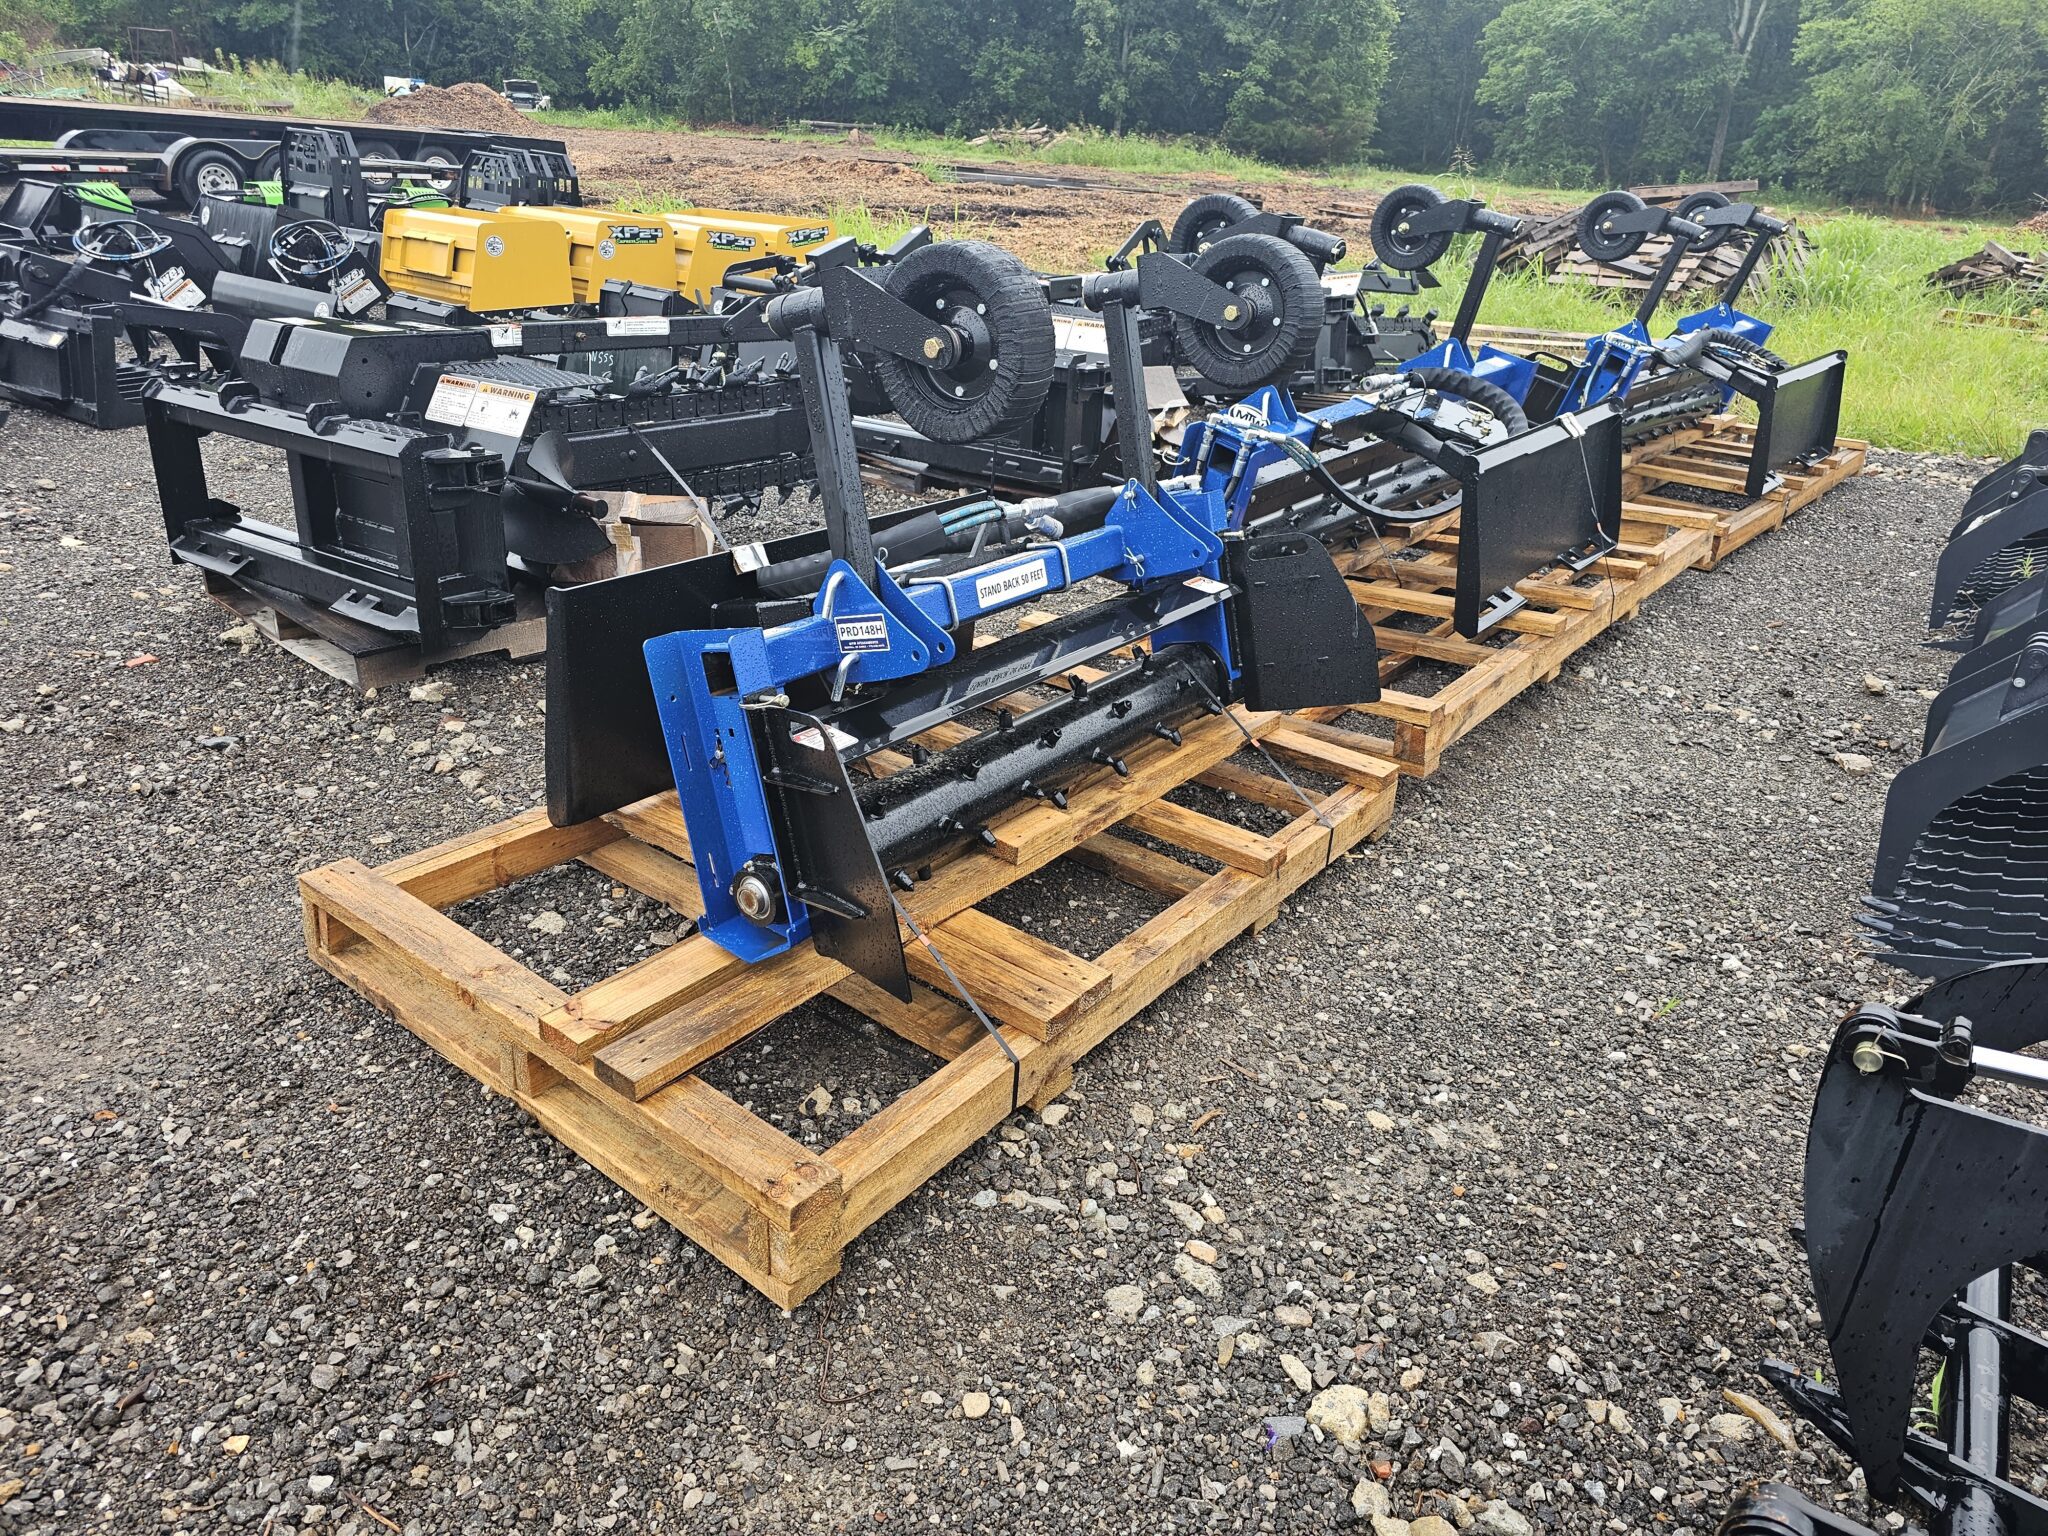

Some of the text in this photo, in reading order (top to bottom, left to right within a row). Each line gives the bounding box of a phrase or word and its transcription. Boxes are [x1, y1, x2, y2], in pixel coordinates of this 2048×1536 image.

[608, 225, 664, 239] XP24
[706, 231, 757, 247] XP30
[786, 226, 830, 244] XP24
[446, 378, 476, 389] WARNING
[490, 387, 531, 401] WARNING
[980, 582, 1001, 599] STAND
[1002, 576, 1020, 591] BACK
[1030, 568, 1044, 582] FEET
[840, 624, 884, 638] PRD148H
